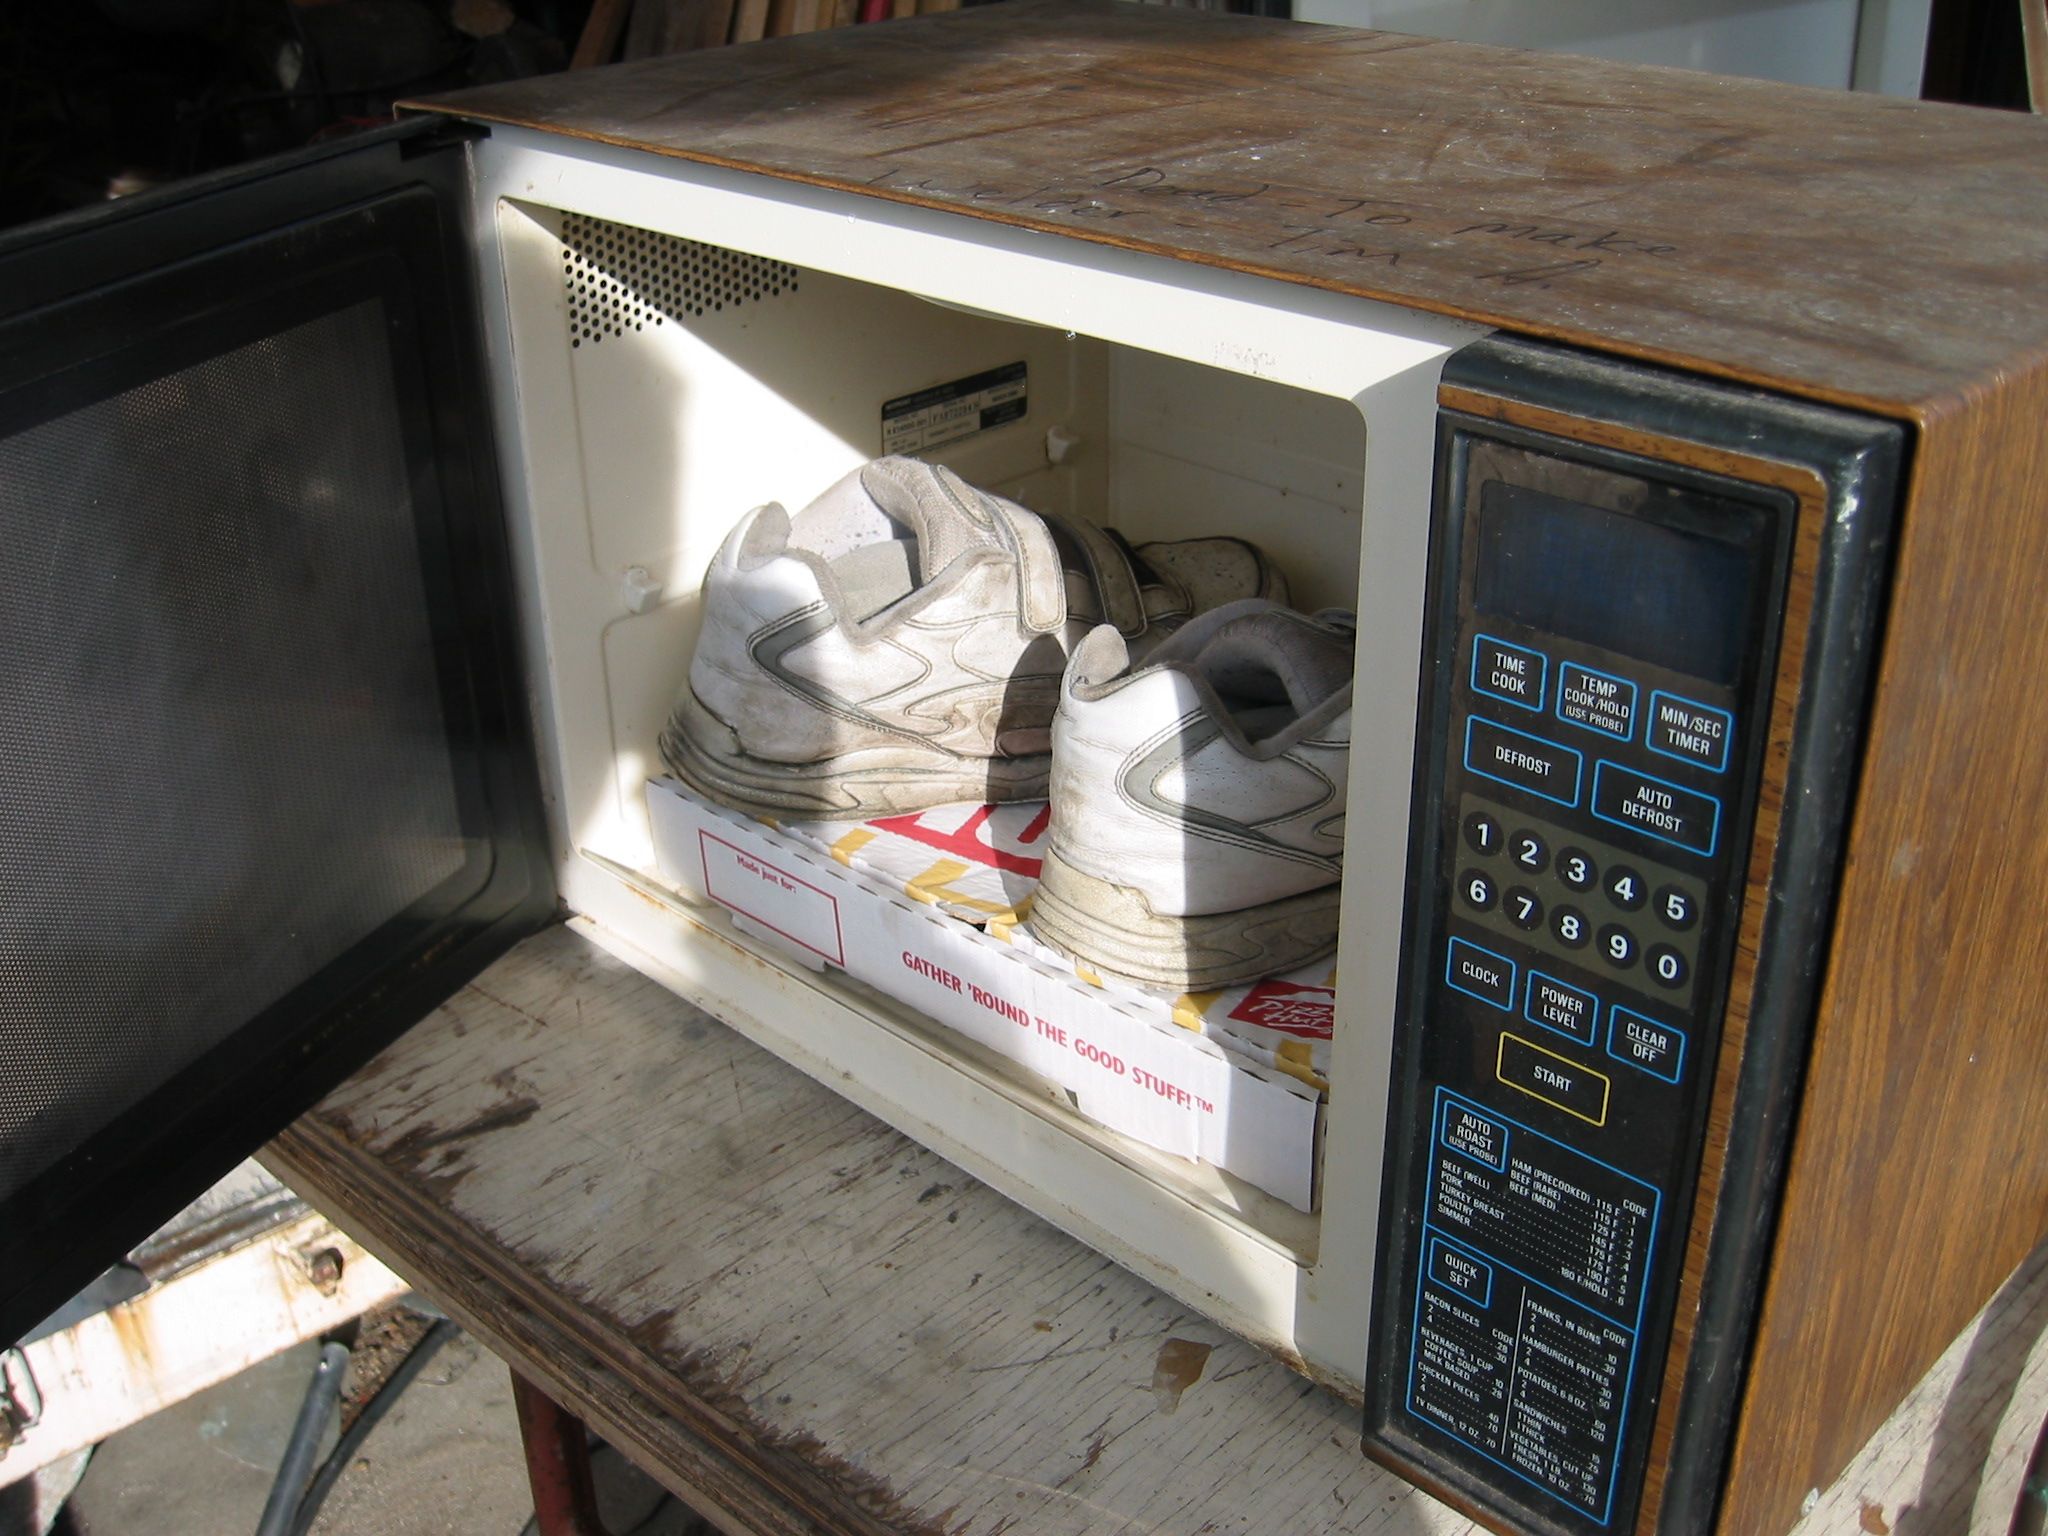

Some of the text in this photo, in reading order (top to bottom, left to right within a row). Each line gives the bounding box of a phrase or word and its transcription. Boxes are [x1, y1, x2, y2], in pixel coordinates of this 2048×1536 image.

[1453, 222, 1677, 258] make
[1495, 652, 1526, 676] TIME
[1490, 671, 1527, 695] COOK
[1581, 674, 1617, 698] TEMP
[1588, 712, 1624, 734] PROBE)
[1667, 728, 1711, 756] TIMER
[1495, 745, 1552, 776] DEFROST
[1636, 786, 1673, 810] AUTO
[1622, 799, 1682, 833] DEFROST
[1477, 823, 1490, 846] 1
[736, 854, 761, 875] Made
[1520, 839, 1539, 866] 2
[1567, 857, 1586, 883] 3
[1469, 879, 1487, 903] 6
[1614, 876, 1635, 902] 4
[1516, 896, 1533, 920] 7
[1665, 893, 1686, 921] 5
[1560, 915, 1580, 940] 8
[1609, 934, 1629, 959] 9
[1461, 960, 1501, 987] CLOCK
[1657, 954, 1679, 980] 0
[1248, 999, 1334, 1018] Pizz
[1541, 985, 1584, 1015] POWER
[902, 950, 963, 996] GATHER
[967, 983, 1031, 1028] 'ROUND
[1034, 1016, 1069, 1048] THE
[1074, 1038, 1126, 1076] GOOD
[1543, 1003, 1578, 1030] LEVEL
[1626, 1021, 1668, 1050] CLEAR
[1632, 1042, 1657, 1062] OFF
[1532, 1064, 1572, 1092] START
[1461, 1113, 1491, 1136] AUTO
[1457, 1126, 1493, 1152] ROAST
[1469, 1144, 1498, 1166] PROBE)
[1441, 1170, 1464, 1189] PORK
[1442, 1159, 1461, 1176] BEEF
[1464, 1170, 1490, 1191] (WELL)
[1511, 1169, 1531, 1187] BEEF
[1533, 1180, 1561, 1201] (RARE)
[1512, 1158, 1532, 1174] HAM
[1534, 1168, 1591, 1204] (PRECOOKED)
[1439, 1192, 1473, 1217] POULTRY
[1440, 1181, 1471, 1205] TURKEY
[1473, 1198, 1505, 1221] BREAST
[1509, 1181, 1530, 1198] BEEF
[1531, 1192, 1556, 1211] (MED)
[1623, 1198, 1648, 1218] CODE
[1437, 1203, 1470, 1227] SIMMER
[1445, 1253, 1477, 1279] QUICK
[1449, 1271, 1469, 1290] SET
[1424, 1291, 1480, 1328] BACON SLICES
[1426, 1313, 1432, 1323] 4
[1427, 1304, 1433, 1314] 2
[1530, 1312, 1536, 1323] 2
[1492, 1327, 1514, 1347] CODE
[1528, 1323, 1535, 1333] 4
[1564, 1319, 1575, 1331] IN
[1577, 1325, 1601, 1346] BUNS
[1603, 1328, 1627, 1348] CODE
[1522, 1333, 1609, 1387] HAMBURGER PATTIES
[1523, 1356, 1530, 1367] 4
[1525, 1346, 1532, 1356] 2
[1445, 1361, 1470, 1382] BASED
[1457, 1356, 1478, 1376] SOUP
[1477, 1357, 1494, 1373] CUP
[1418, 1361, 1480, 1403] CHICKEN PIECES
[1419, 1382, 1426, 1392] 4
[1421, 1373, 1426, 1383] 2
[1521, 1379, 1527, 1389] 2
[1519, 1388, 1526, 1399] 4
[1415, 1396, 1425, 1407] TV
[1458, 1421, 1466, 1432] 12
[1513, 1397, 1568, 1435] SANDWICHES
[1523, 1414, 1542, 1431] THIN
[1521, 1424, 1545, 1444] THICK
[1562, 1459, 1579, 1476] CUT
[1580, 1470, 1594, 1484] UP
